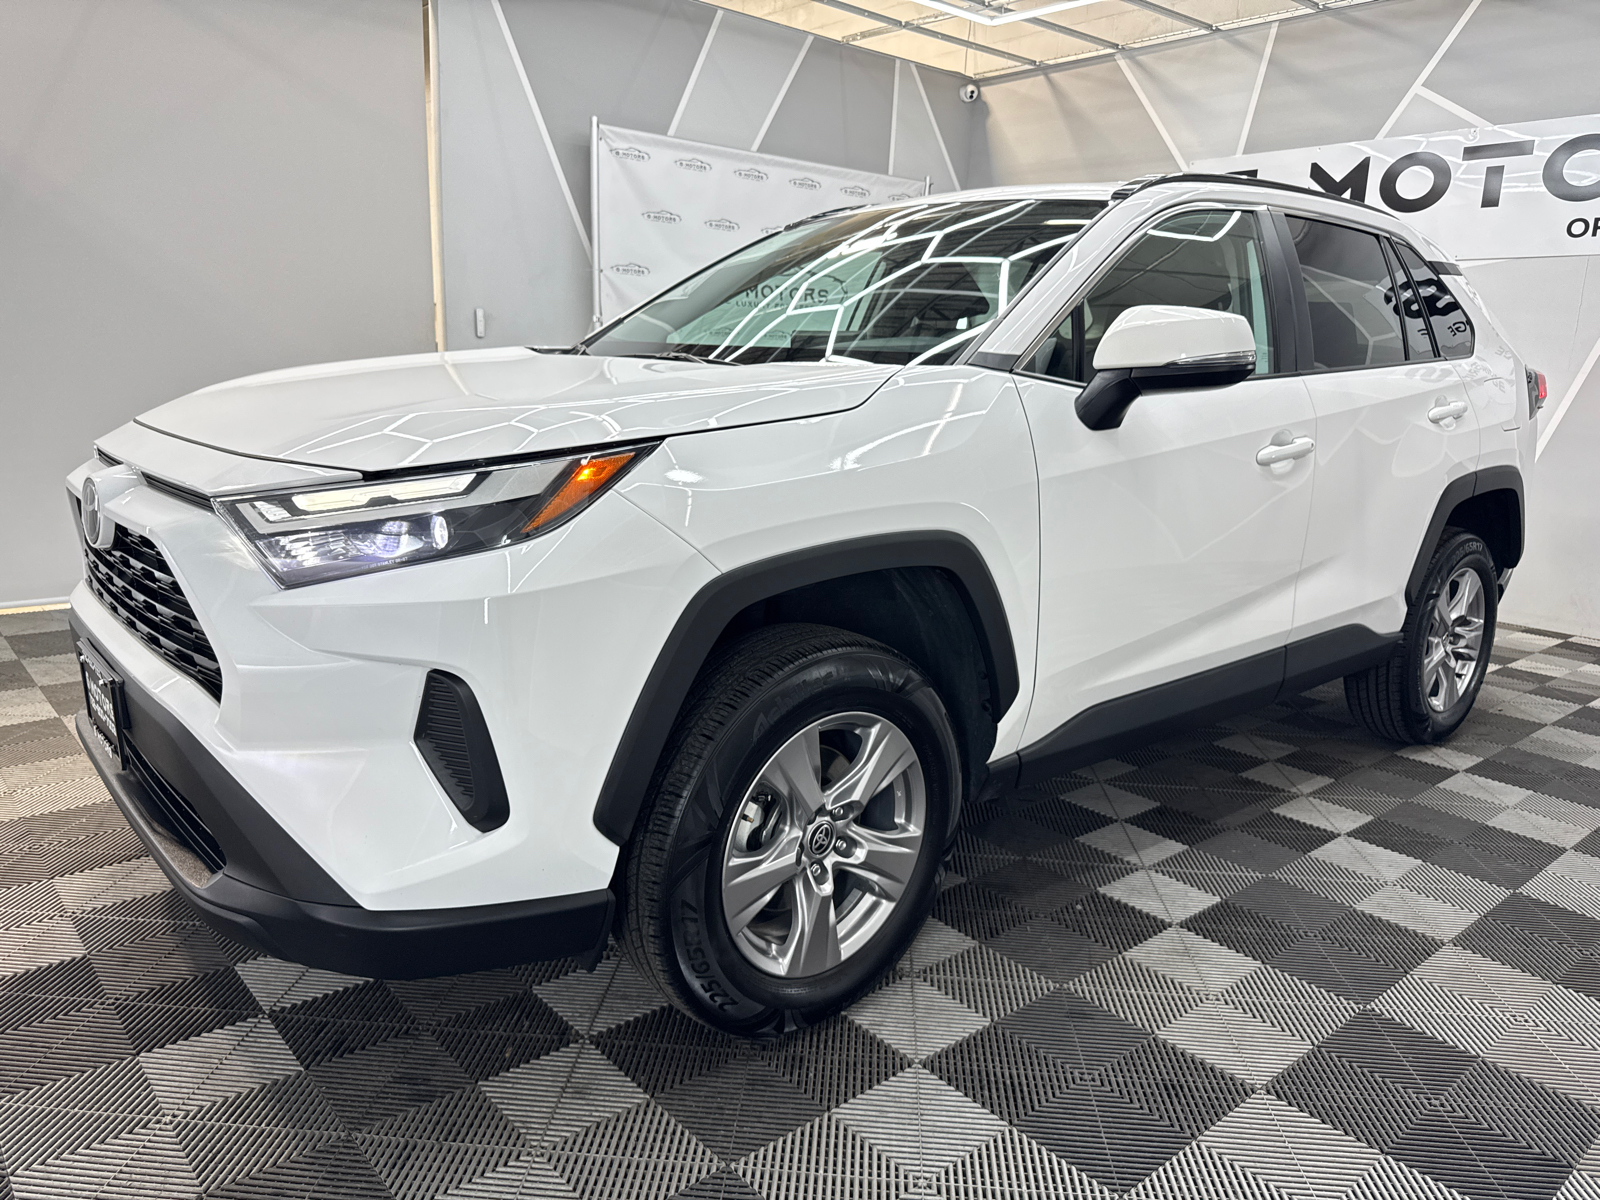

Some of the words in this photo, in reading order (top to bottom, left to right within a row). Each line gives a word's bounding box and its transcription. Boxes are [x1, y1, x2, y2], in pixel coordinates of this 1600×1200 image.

[621, 152, 645, 161] MOTORS
[685, 163, 707, 171] MOTORS
[744, 173, 764, 181] MOTORS
[799, 182, 817, 190] MOTORS
[653, 215, 677, 223] MOTORS
[714, 223, 736, 231] MOTORS
[622, 268, 645, 276] MOTORS
[736, 300, 770, 309] LUXUY
[680, 898, 739, 1013] 225/65R17
